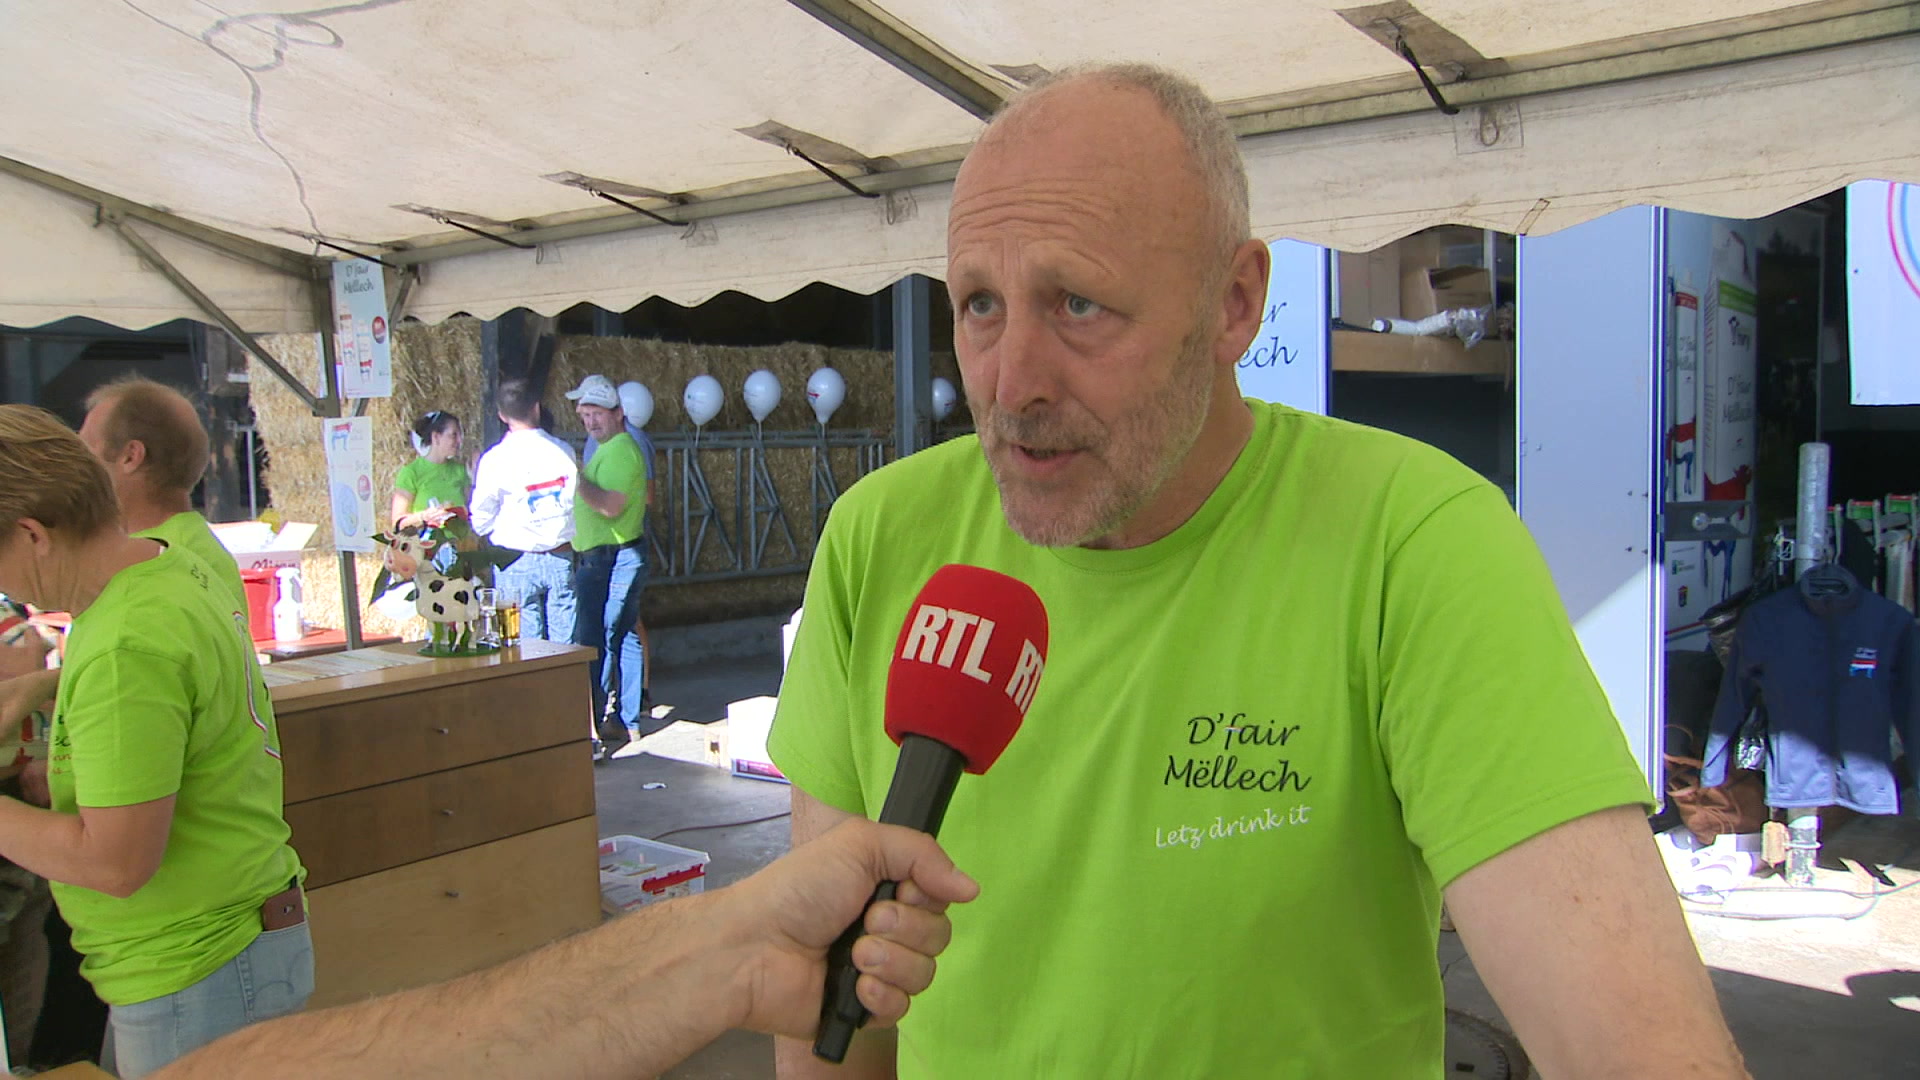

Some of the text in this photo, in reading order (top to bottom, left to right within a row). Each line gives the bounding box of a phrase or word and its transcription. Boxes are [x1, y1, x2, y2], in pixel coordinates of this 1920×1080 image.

[901, 604, 996, 684] RTL
[1187, 712, 1300, 750] D'fair
[1164, 755, 1312, 792] Mëllech
[1155, 804, 1312, 849] Letz drink it
